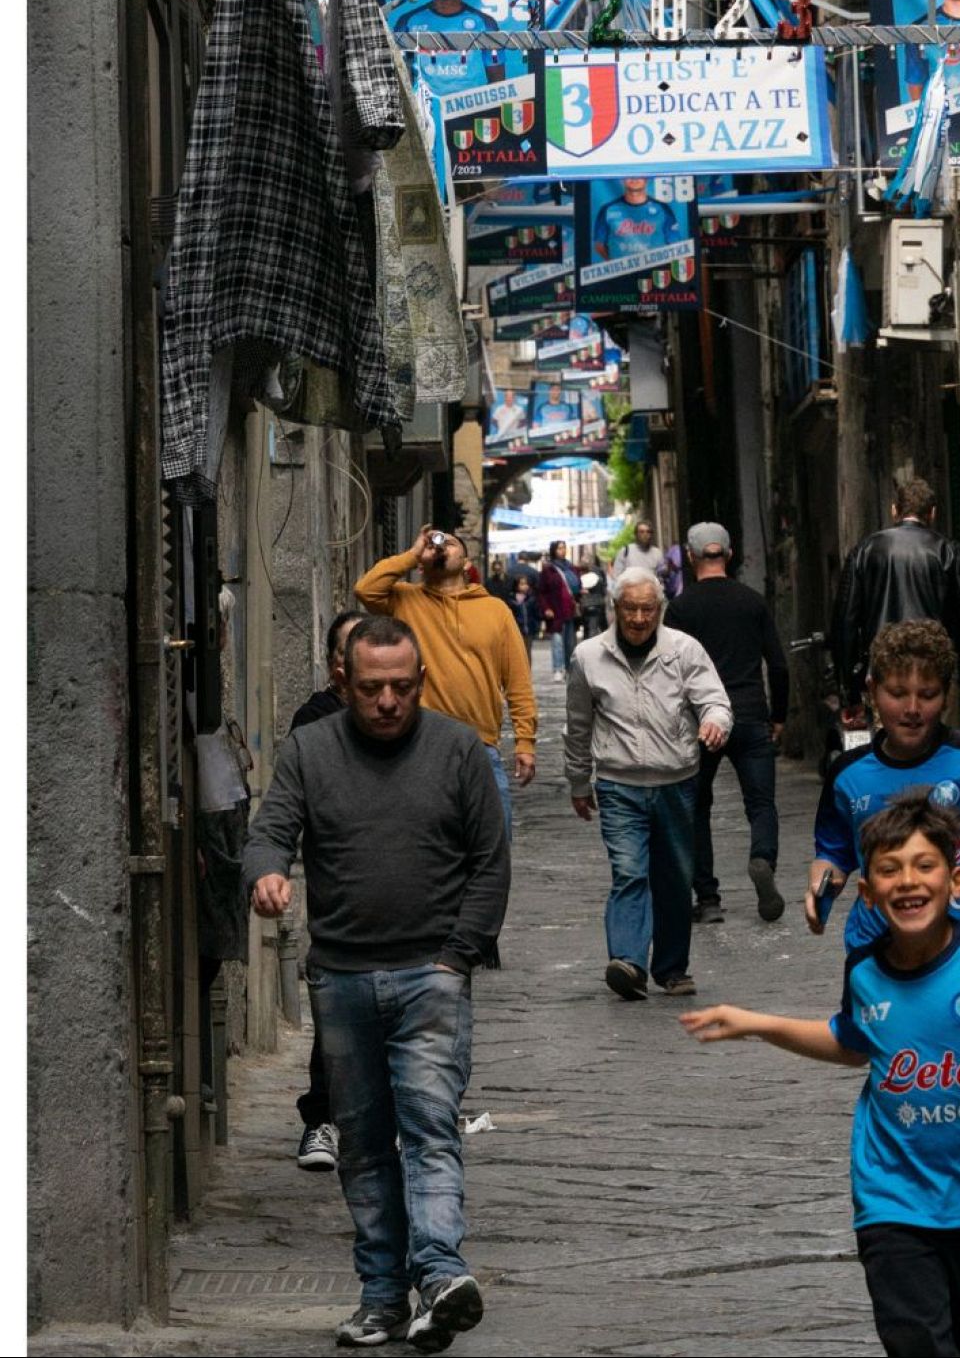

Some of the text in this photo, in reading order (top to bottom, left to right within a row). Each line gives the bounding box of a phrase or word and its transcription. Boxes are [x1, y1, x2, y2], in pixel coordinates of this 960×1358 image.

[437, 65, 469, 77] MSC
[623, 58, 721, 82] CHIST'
[445, 83, 519, 114] ANGUISSA
[562, 83, 594, 128] 3
[626, 89, 802, 115] DEDICAT A TE
[627, 118, 788, 156] O' PAZZ
[457, 148, 537, 164] D'ITALIA
